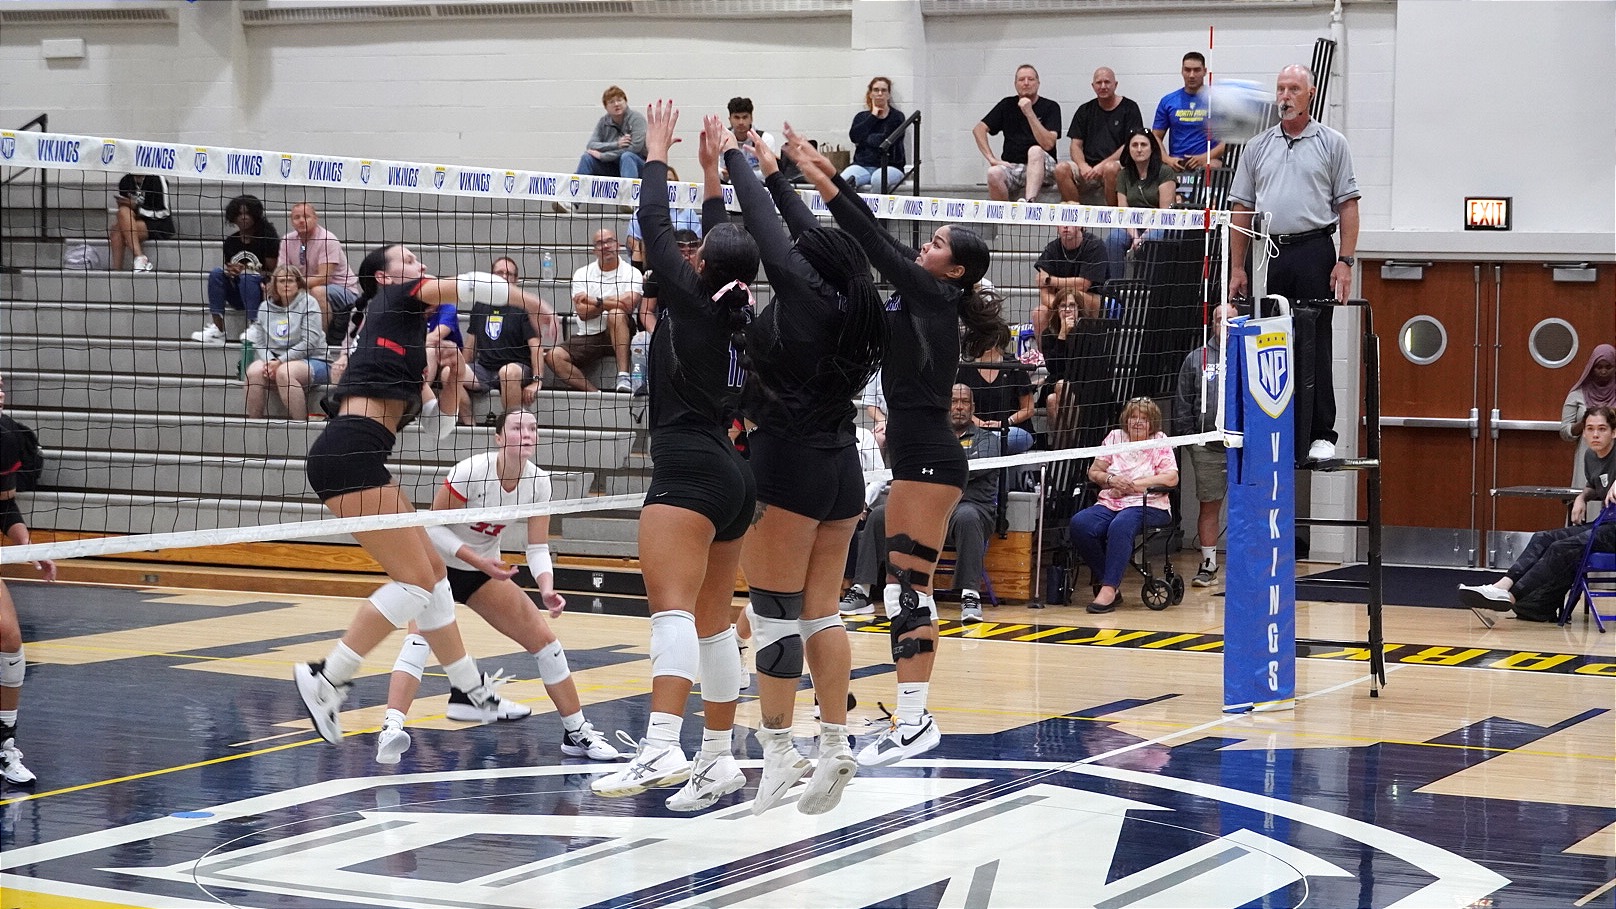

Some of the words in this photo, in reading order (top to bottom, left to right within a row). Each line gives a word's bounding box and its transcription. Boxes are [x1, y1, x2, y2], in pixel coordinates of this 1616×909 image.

[38, 139, 80, 163] VIKINGS
[135, 145, 176, 170] VIKINGS
[227, 153, 263, 176] VIKINGS
[308, 160, 343, 182] VIKINGS
[388, 166, 419, 187] VIKINGS
[459, 171, 491, 192] VIKINGS
[528, 176, 556, 196] VIKINGS
[591, 180, 619, 199] VIKINGS
[1471, 201, 1503, 226] EXIT
[1259, 350, 1287, 396] NP
[1268, 432, 1281, 691] VIKINGS
